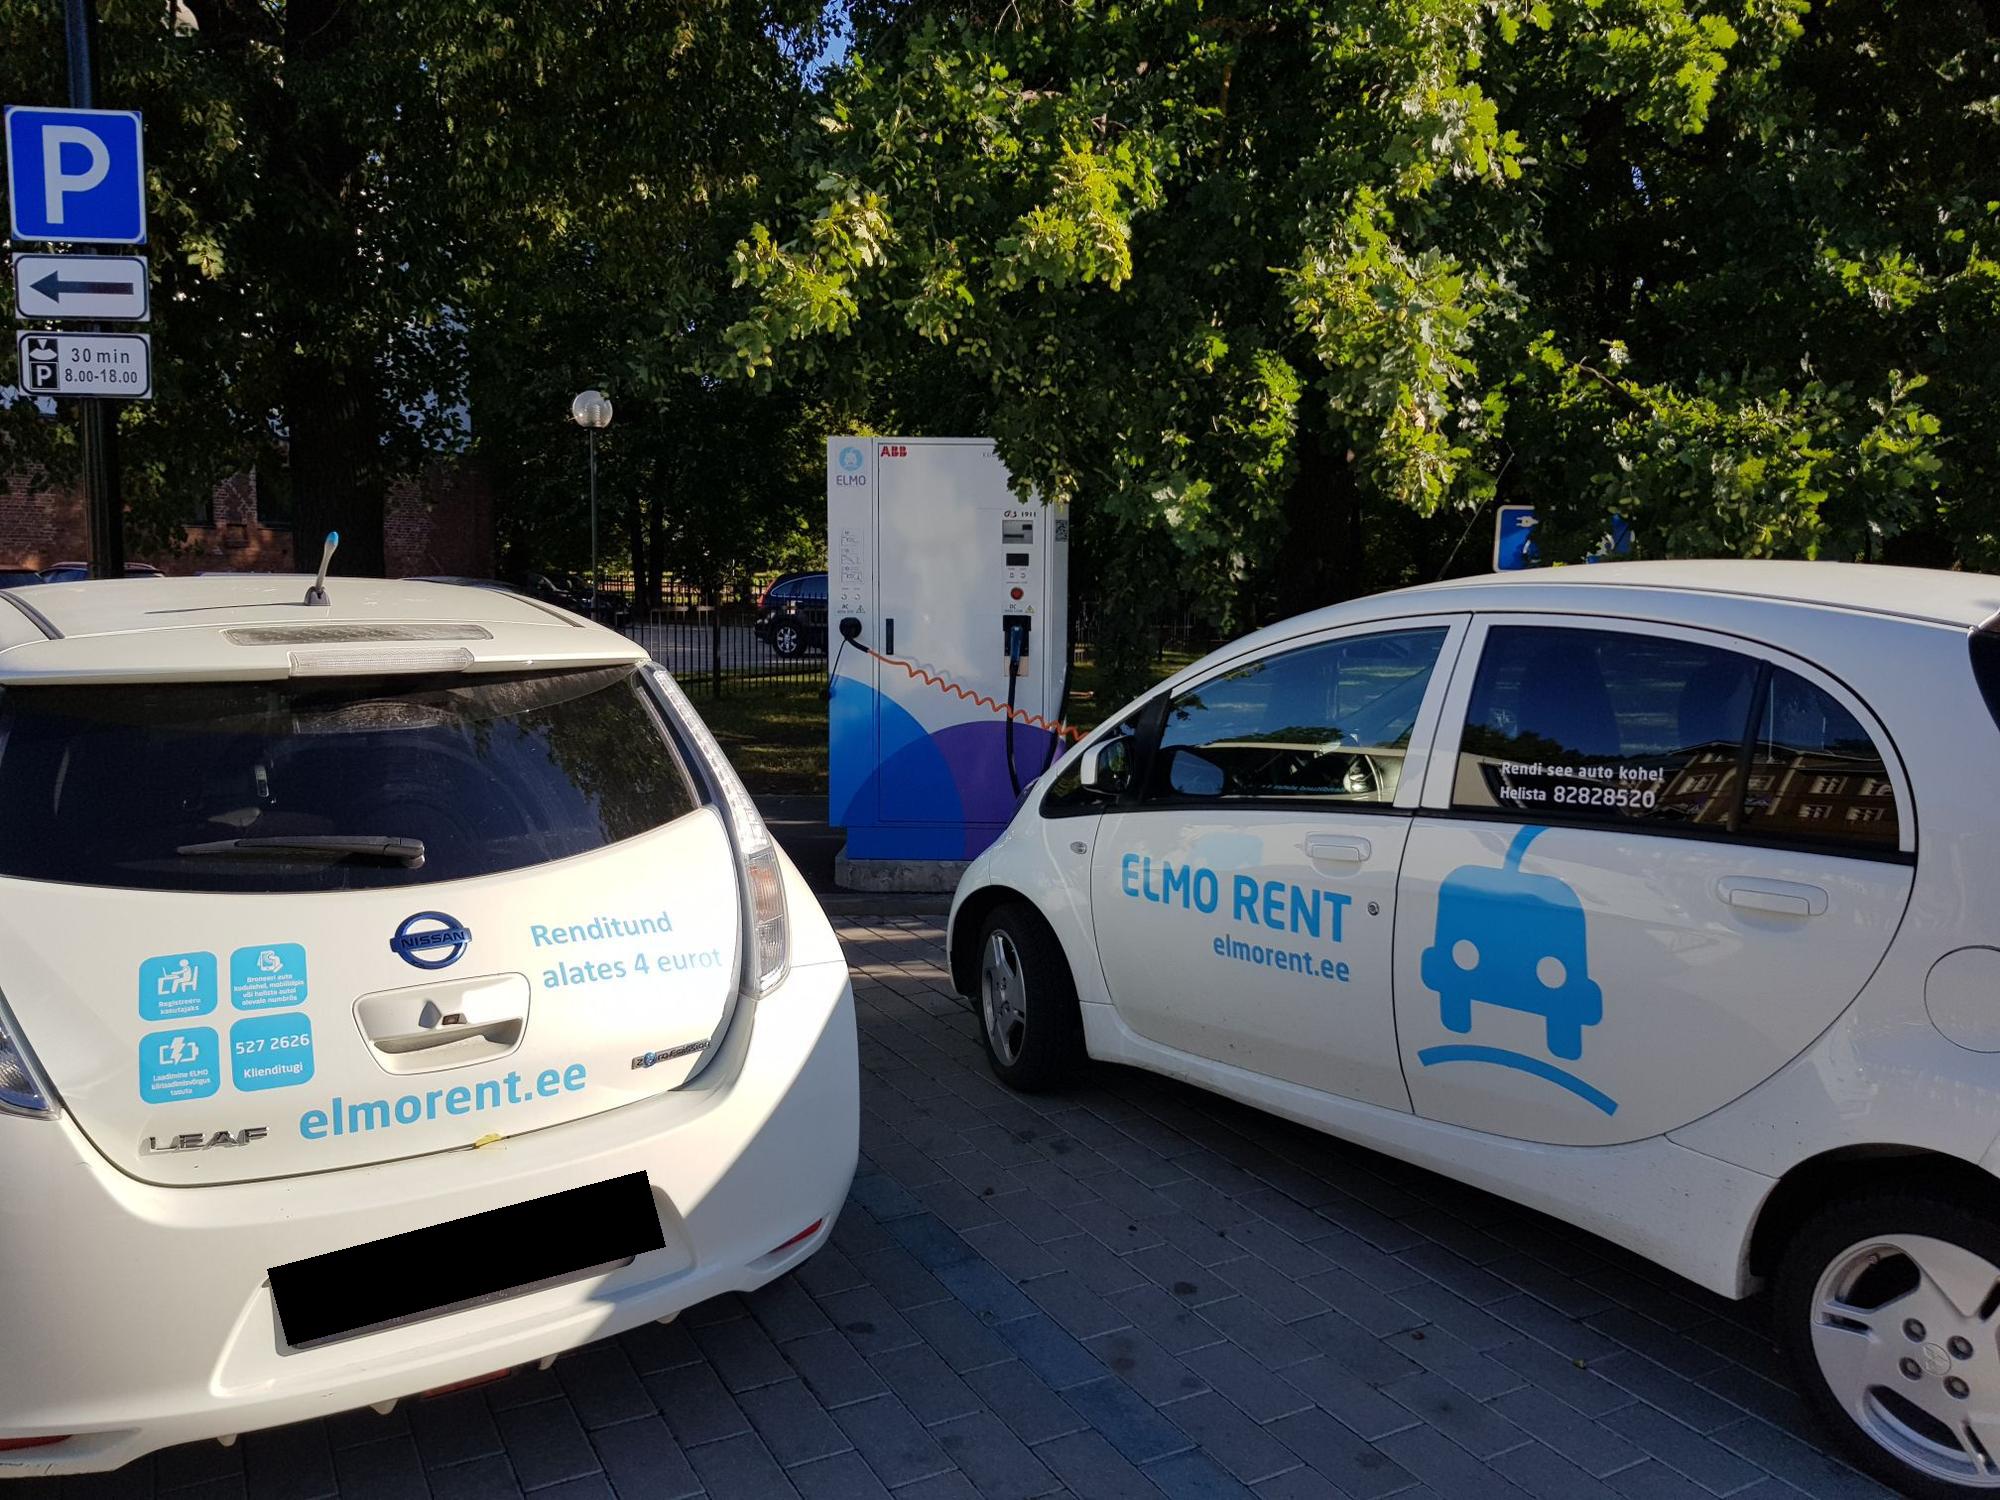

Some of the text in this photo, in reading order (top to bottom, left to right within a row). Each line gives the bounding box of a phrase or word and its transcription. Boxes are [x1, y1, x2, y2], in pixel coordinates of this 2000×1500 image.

[42, 125, 110, 224] P
[71, 348, 130, 364] 30 min
[36, 365, 52, 386] P
[65, 368, 138, 383] 8.00-18.00
[881, 446, 908, 457] ABB
[836, 475, 866, 486] ELMO
[1501, 761, 1664, 781] Rendi see auto kohe!
[1500, 786, 1656, 809] Helista 82828520
[1121, 853, 1352, 943] ELMO RENT
[401, 930, 465, 948] NISSAN
[530, 911, 673, 947] Renditund
[542, 947, 722, 989] alates 4 eurot
[1213, 933, 1350, 983] elmorent.ee
[236, 1033, 310, 1055] 527 2626
[243, 1062, 303, 1079] Klienditugi
[300, 1063, 587, 1140] elmorent.ee
[149, 1126, 270, 1153] LEAF
